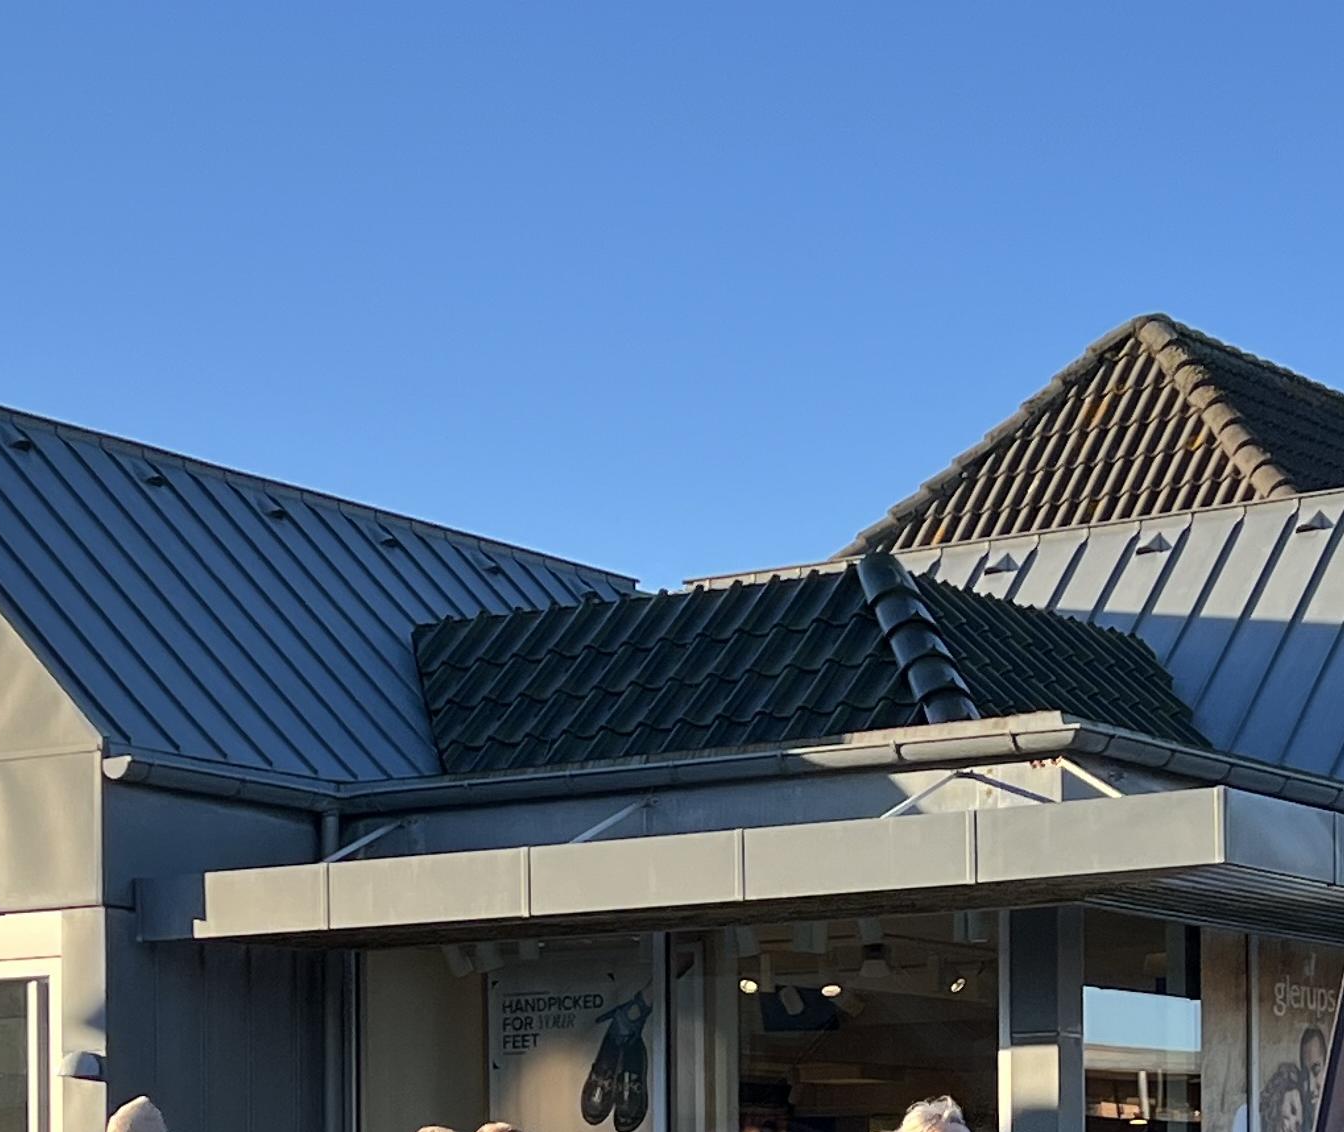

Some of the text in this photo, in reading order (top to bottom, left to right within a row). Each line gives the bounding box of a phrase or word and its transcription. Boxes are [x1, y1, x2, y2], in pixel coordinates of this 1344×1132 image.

[502, 994, 604, 1014] HANDPICKED
[1273, 974, 1337, 1018] glerups
[502, 1016, 534, 1032] FOR
[502, 1033, 540, 1049] FEET
